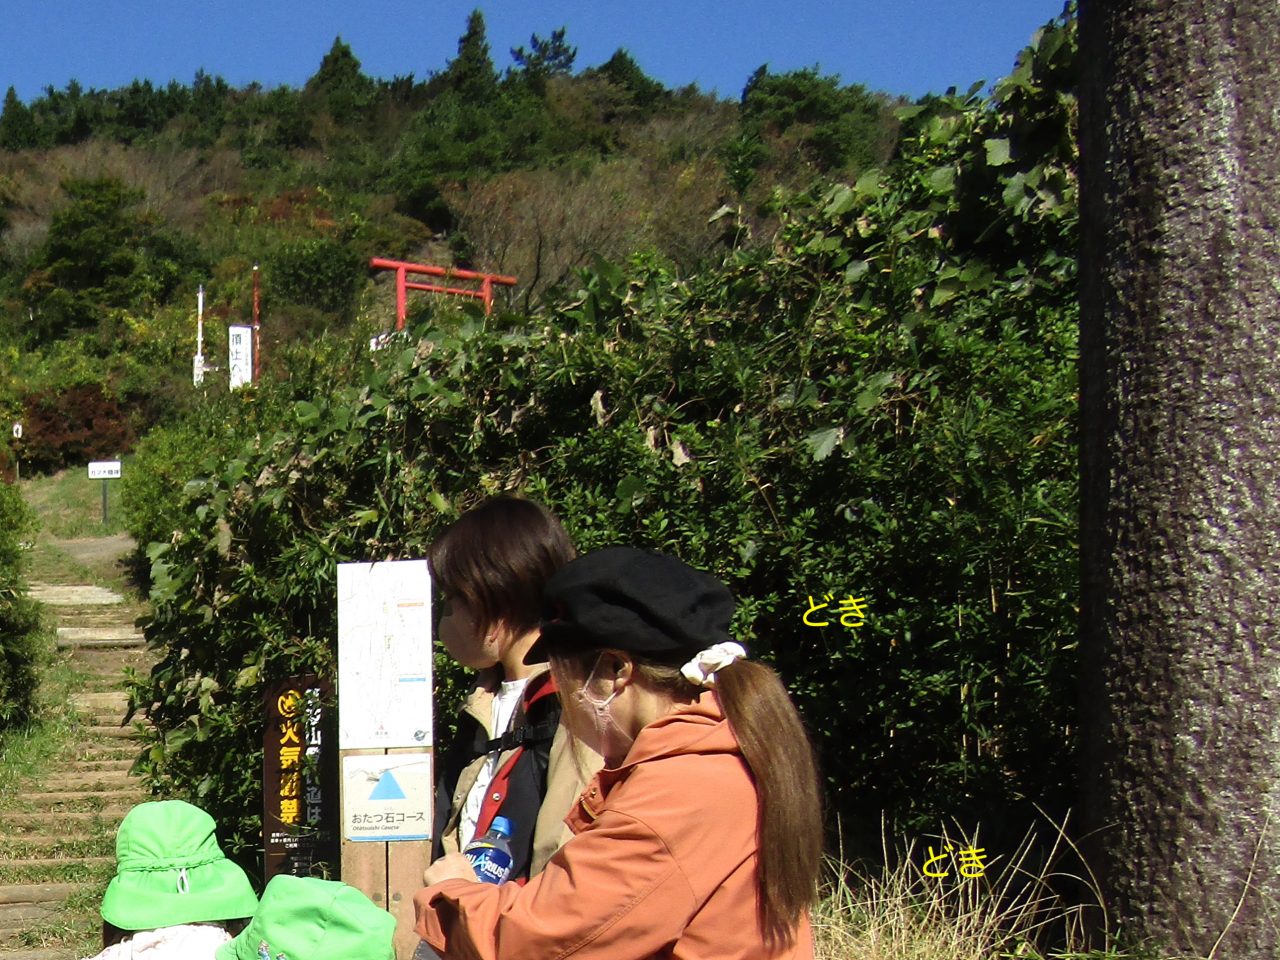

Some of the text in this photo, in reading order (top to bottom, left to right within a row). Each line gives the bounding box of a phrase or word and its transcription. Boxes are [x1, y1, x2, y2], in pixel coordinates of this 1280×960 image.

[351, 812, 426, 824] おたつ石コース
